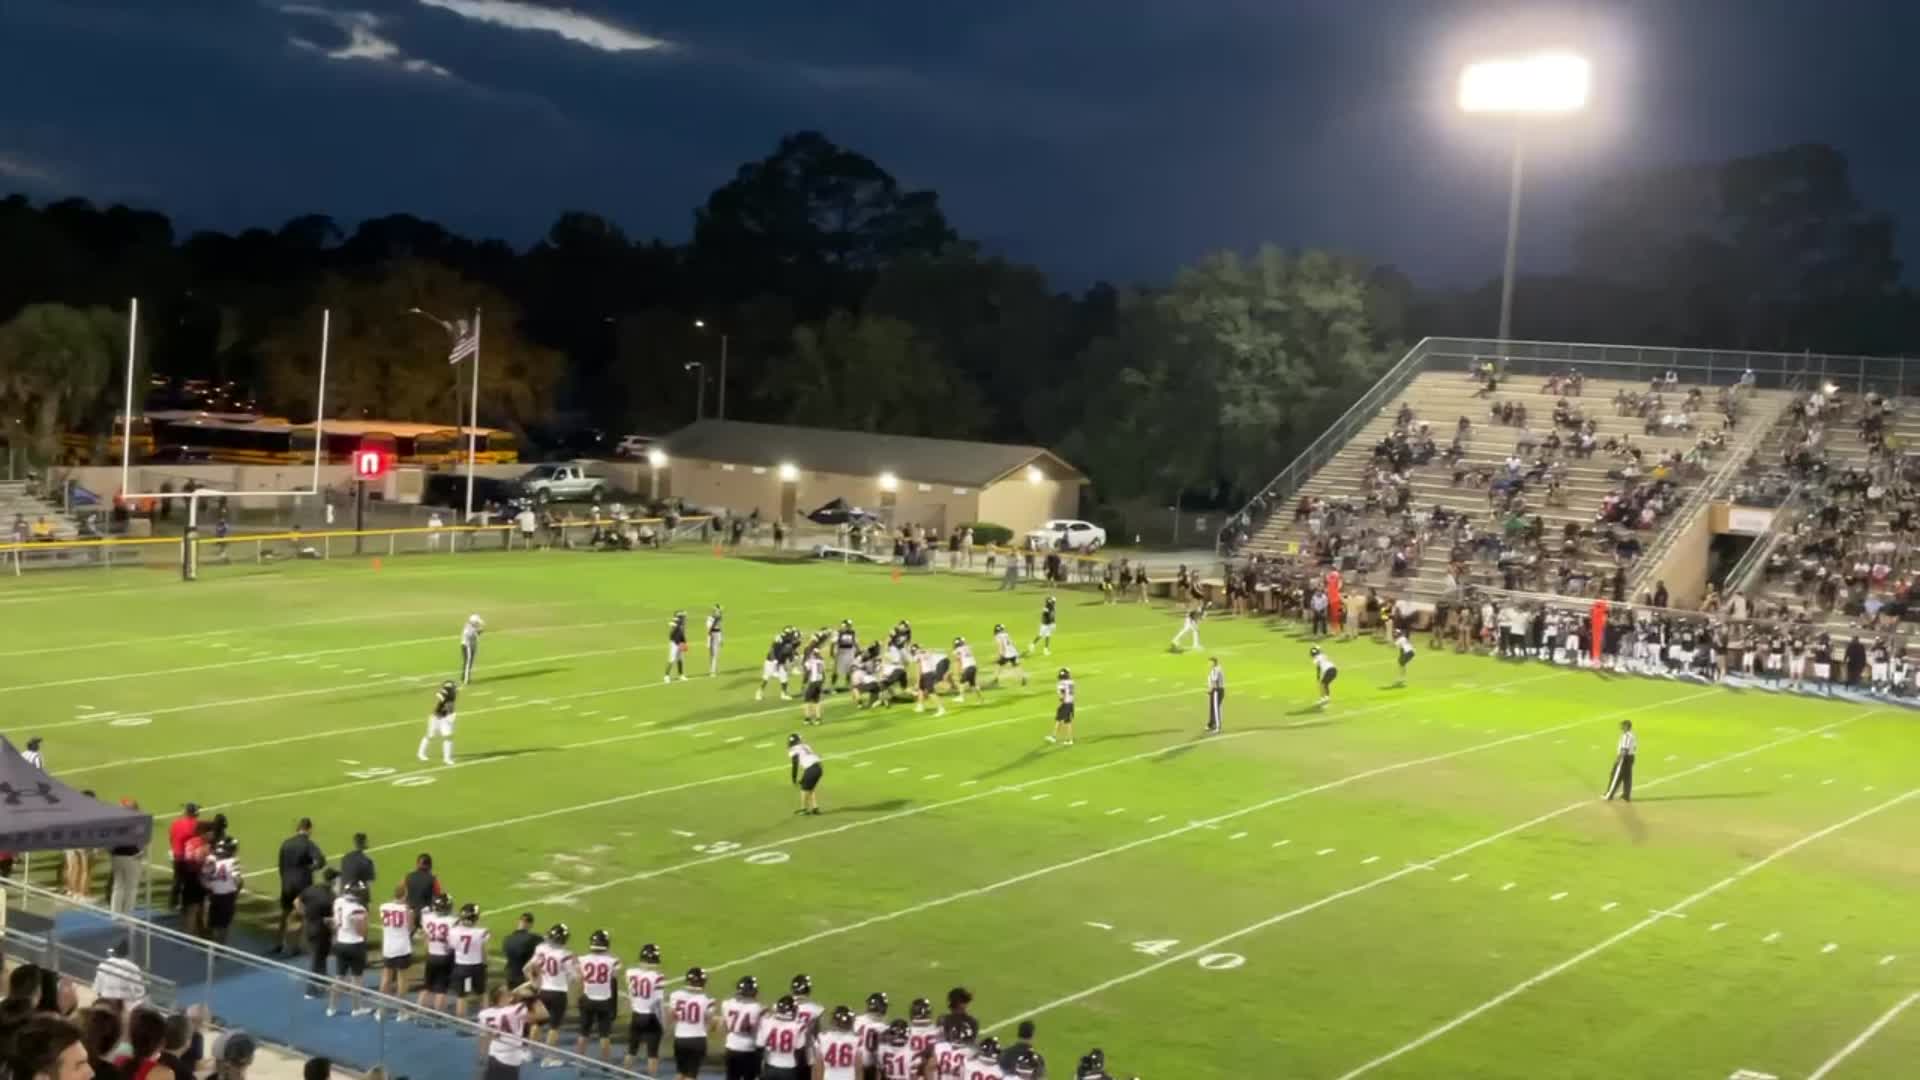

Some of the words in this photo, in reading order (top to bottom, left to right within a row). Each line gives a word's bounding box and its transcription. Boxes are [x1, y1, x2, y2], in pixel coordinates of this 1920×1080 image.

[460, 935, 472, 954] 7
[1131, 939, 1246, 970] 40
[584, 962, 608, 984] 28
[629, 975, 650, 999] 30
[675, 1001, 700, 1024] 50
[766, 1027, 794, 1053] 48
[825, 1042, 853, 1067] 46
[882, 1051, 906, 1075] 51
